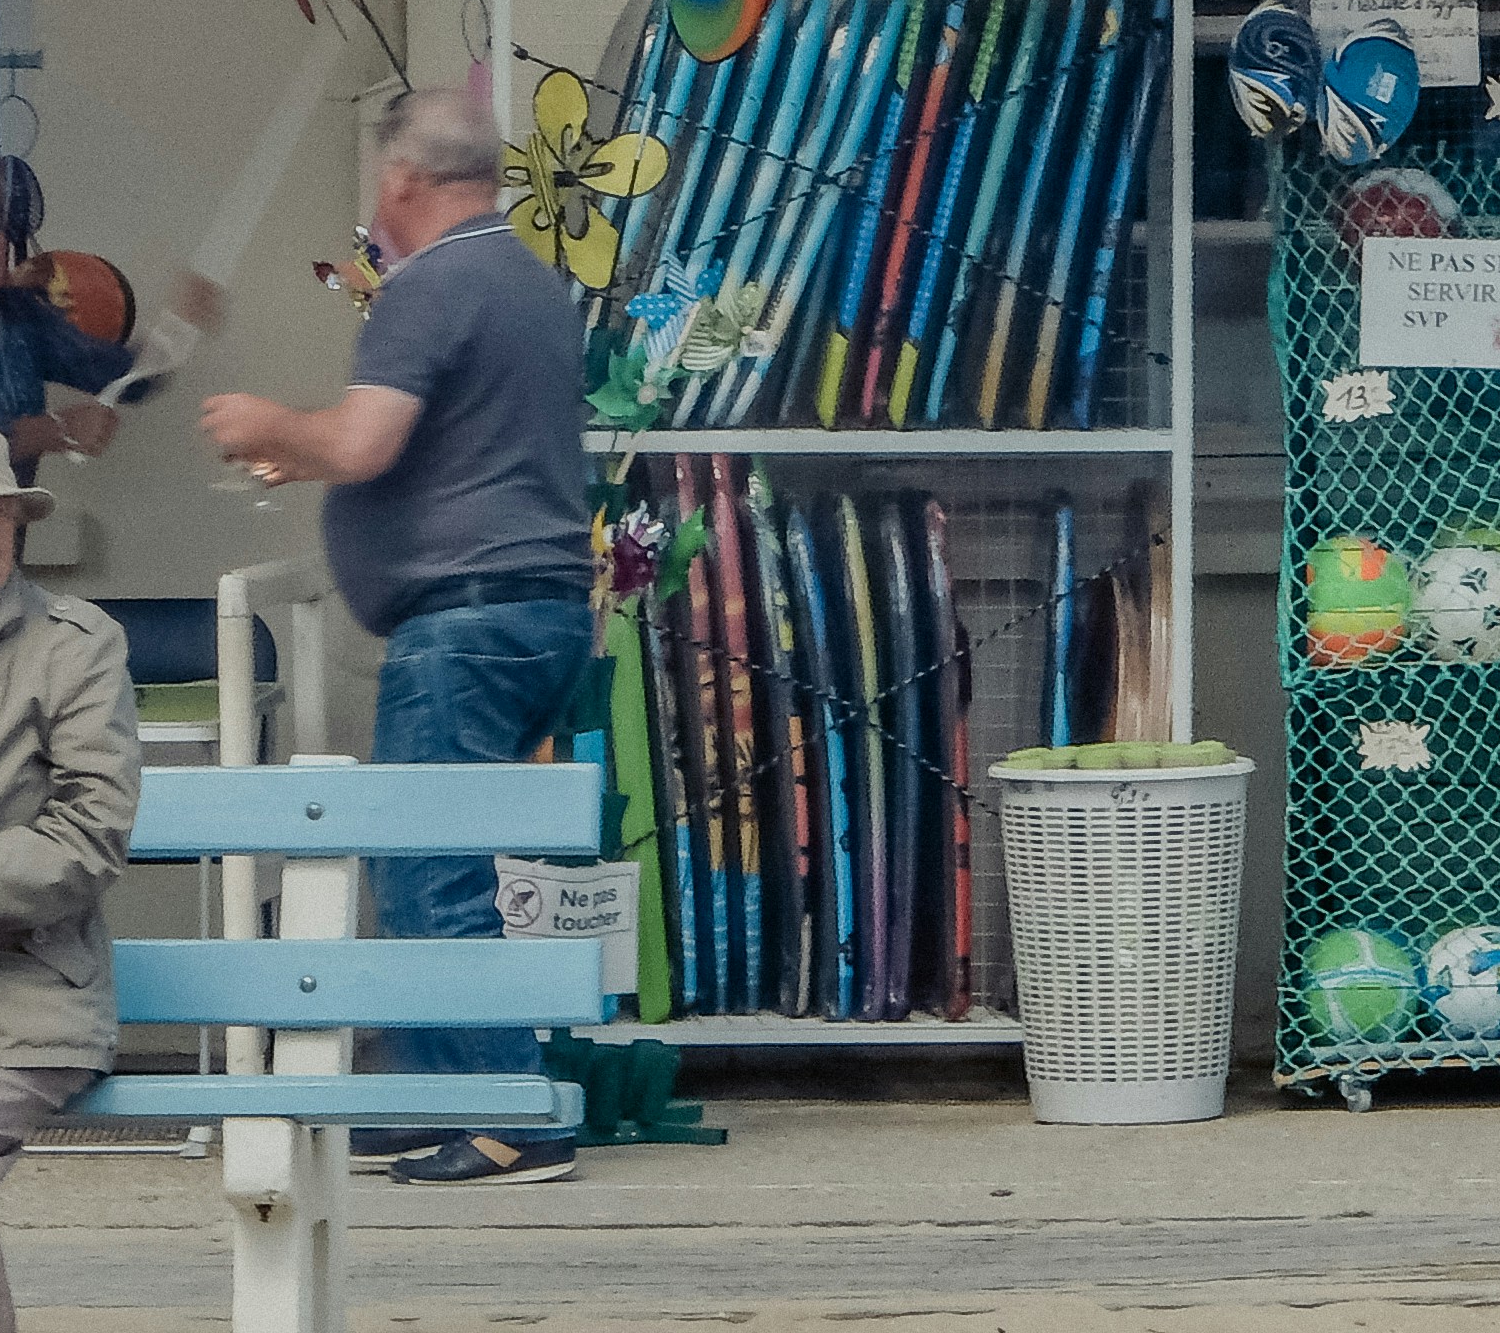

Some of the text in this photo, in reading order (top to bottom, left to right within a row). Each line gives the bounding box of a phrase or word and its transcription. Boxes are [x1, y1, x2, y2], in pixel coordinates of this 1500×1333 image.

[1387, 251, 1423, 273] NE
[1429, 252, 1476, 273] PAS
[1407, 282, 1498, 303] SERVIR
[1402, 310, 1449, 329] SVP
[559, 887, 618, 910] Ne pas
[552, 911, 622, 932] toucher
